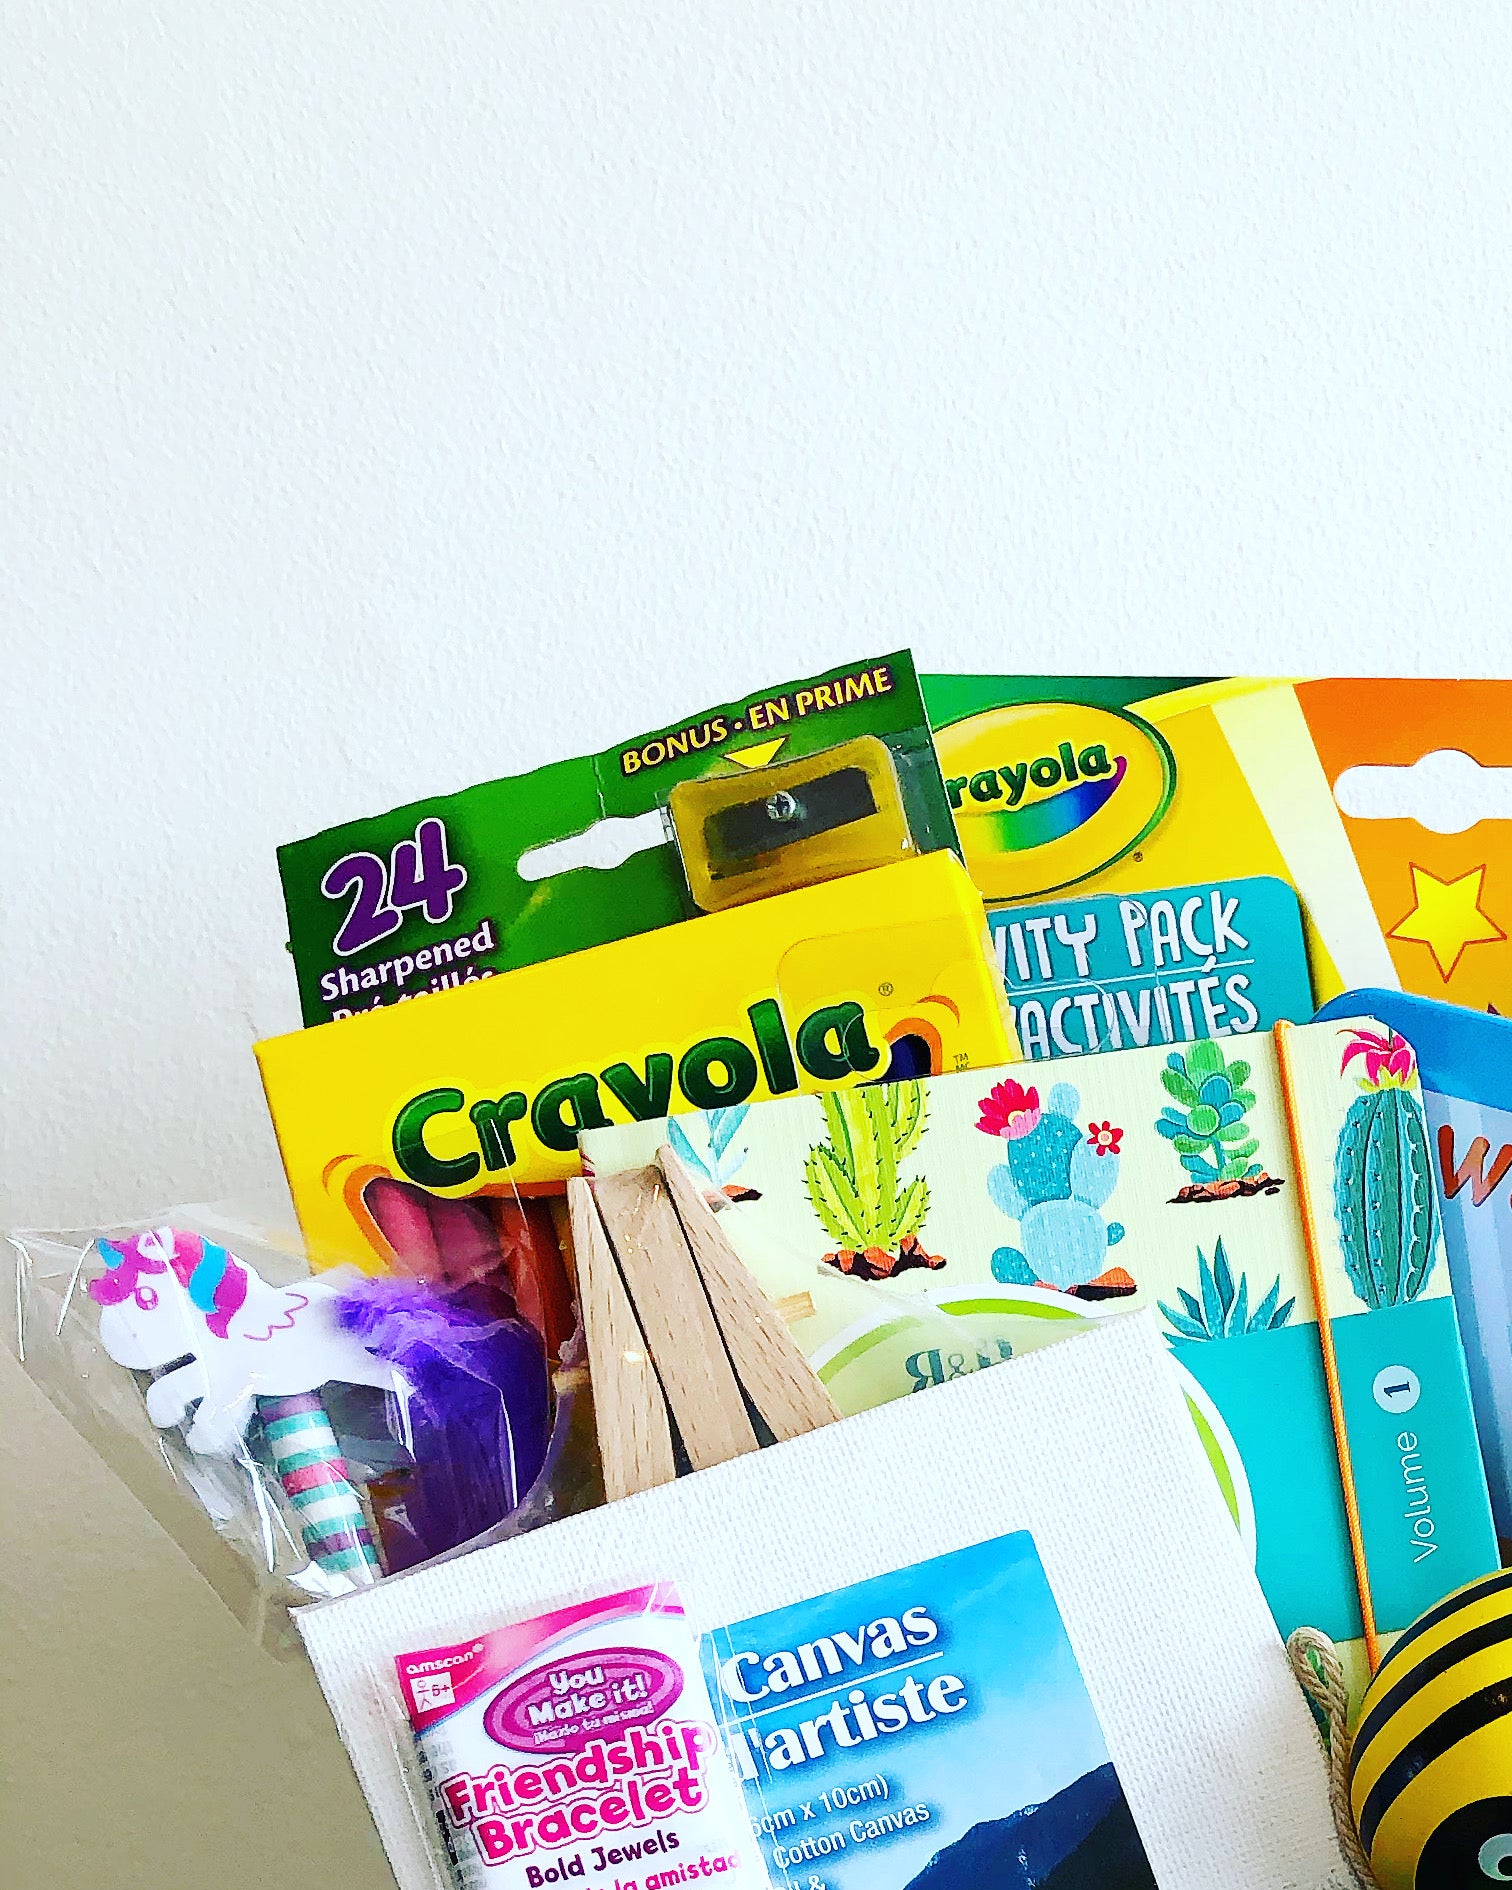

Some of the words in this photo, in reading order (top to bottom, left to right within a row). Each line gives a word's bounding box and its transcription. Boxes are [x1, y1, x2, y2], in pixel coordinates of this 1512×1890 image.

[622, 718, 727, 775] BONUS
[749, 698, 789, 729] EN
[795, 667, 892, 715] PRIME
[321, 817, 467, 957] 24
[320, 921, 494, 1001] Sharpened
[1119, 891, 1249, 966] PACK
[392, 998, 880, 1187] Crayola
[1383, 1381, 1410, 1398] 1
[1397, 1431, 1438, 1563] Volume
[406, 1651, 474, 1674] amscan
[549, 1667, 604, 1695] You
[721, 1606, 937, 1703] Canvas
[527, 1691, 607, 1725] Make
[611, 1675, 649, 1704] it!
[729, 1675, 967, 1781] l'artiste
[444, 1725, 713, 1821] Friendship
[799, 1802, 816, 1820] x
[819, 1774, 889, 1813] 10cm)
[477, 1767, 702, 1860] Bracelet
[772, 1832, 846, 1869] Cotton
[850, 1803, 930, 1843] Canvas
[525, 1854, 585, 1889] Bold
[592, 1830, 680, 1872] Jewels
